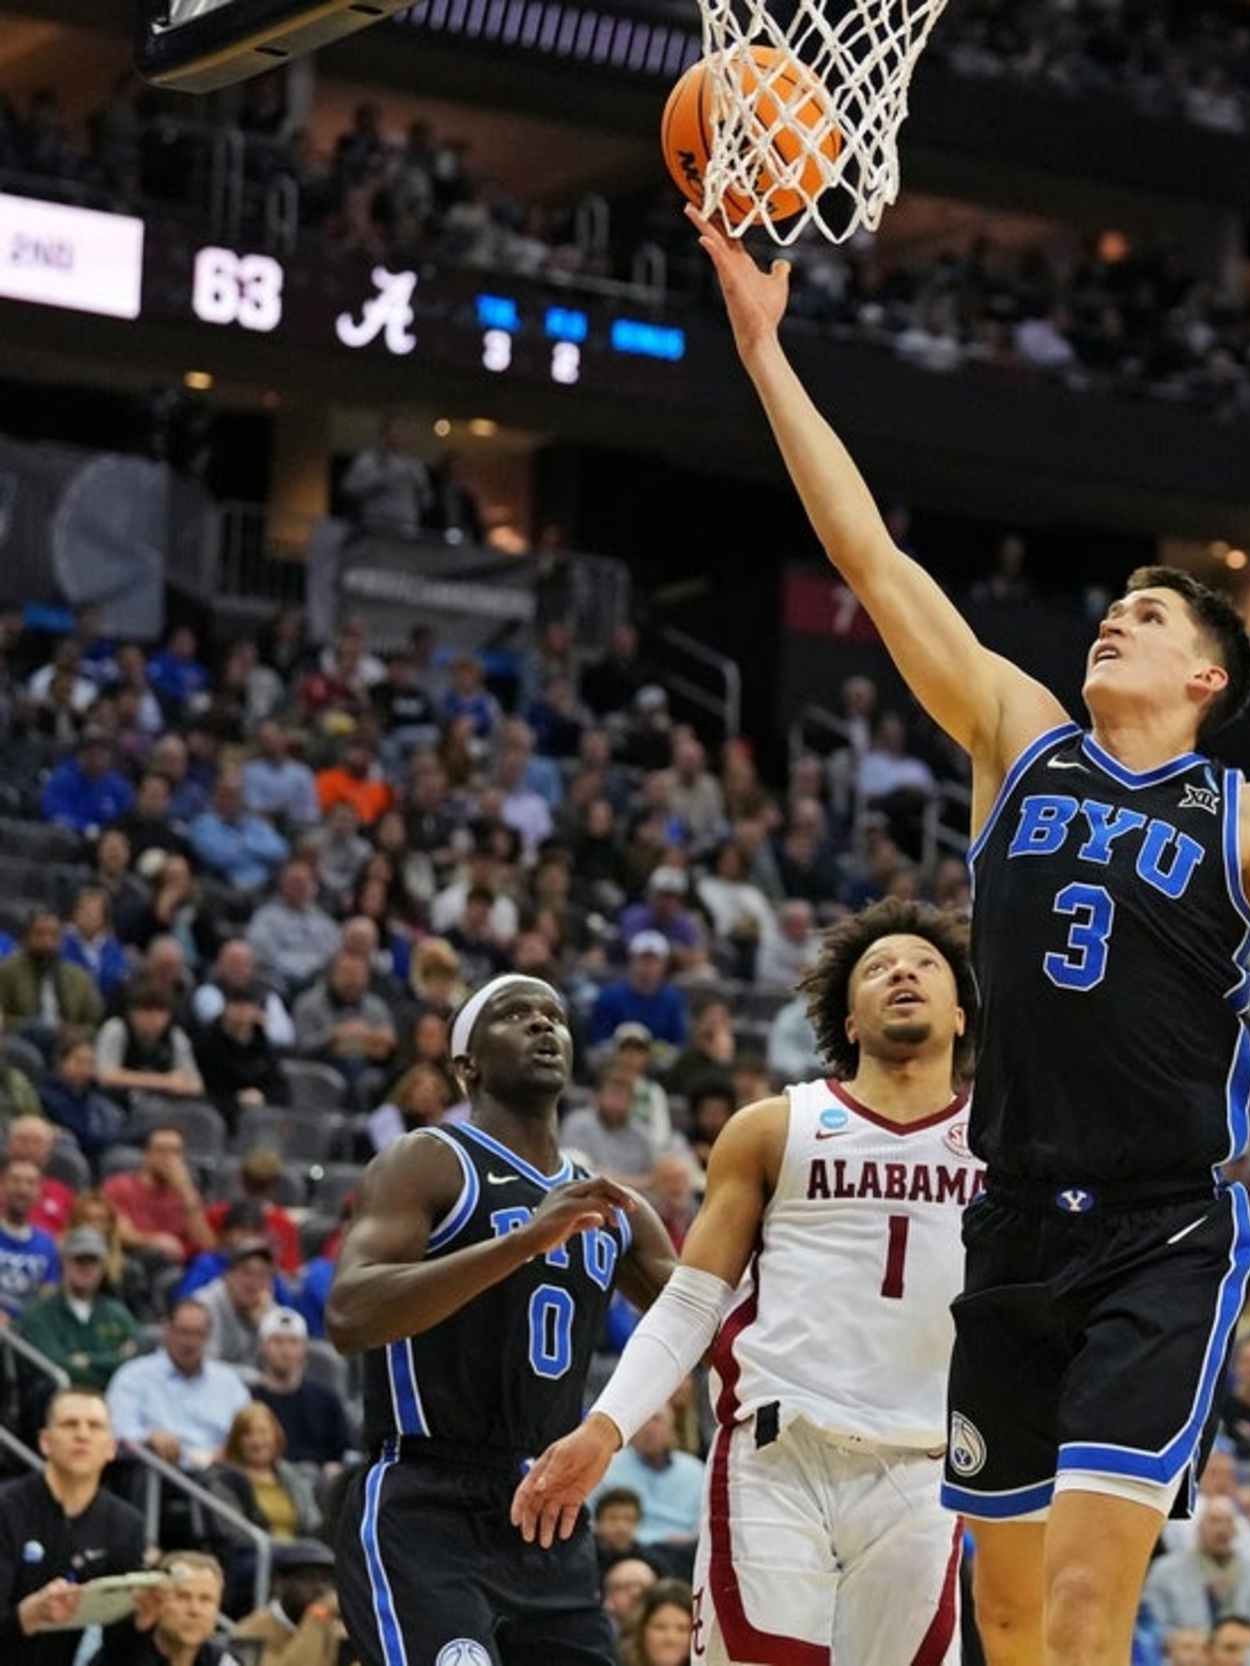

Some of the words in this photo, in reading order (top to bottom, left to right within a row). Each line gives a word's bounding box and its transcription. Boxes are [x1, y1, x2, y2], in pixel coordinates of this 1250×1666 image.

[193, 246, 283, 332] 63
[1007, 795, 1206, 900] BYU
[1043, 881, 1115, 992] 3
[1060, 1189, 1088, 1213] Y
[880, 1214, 910, 1300] 1
[528, 1283, 575, 1380] 0
